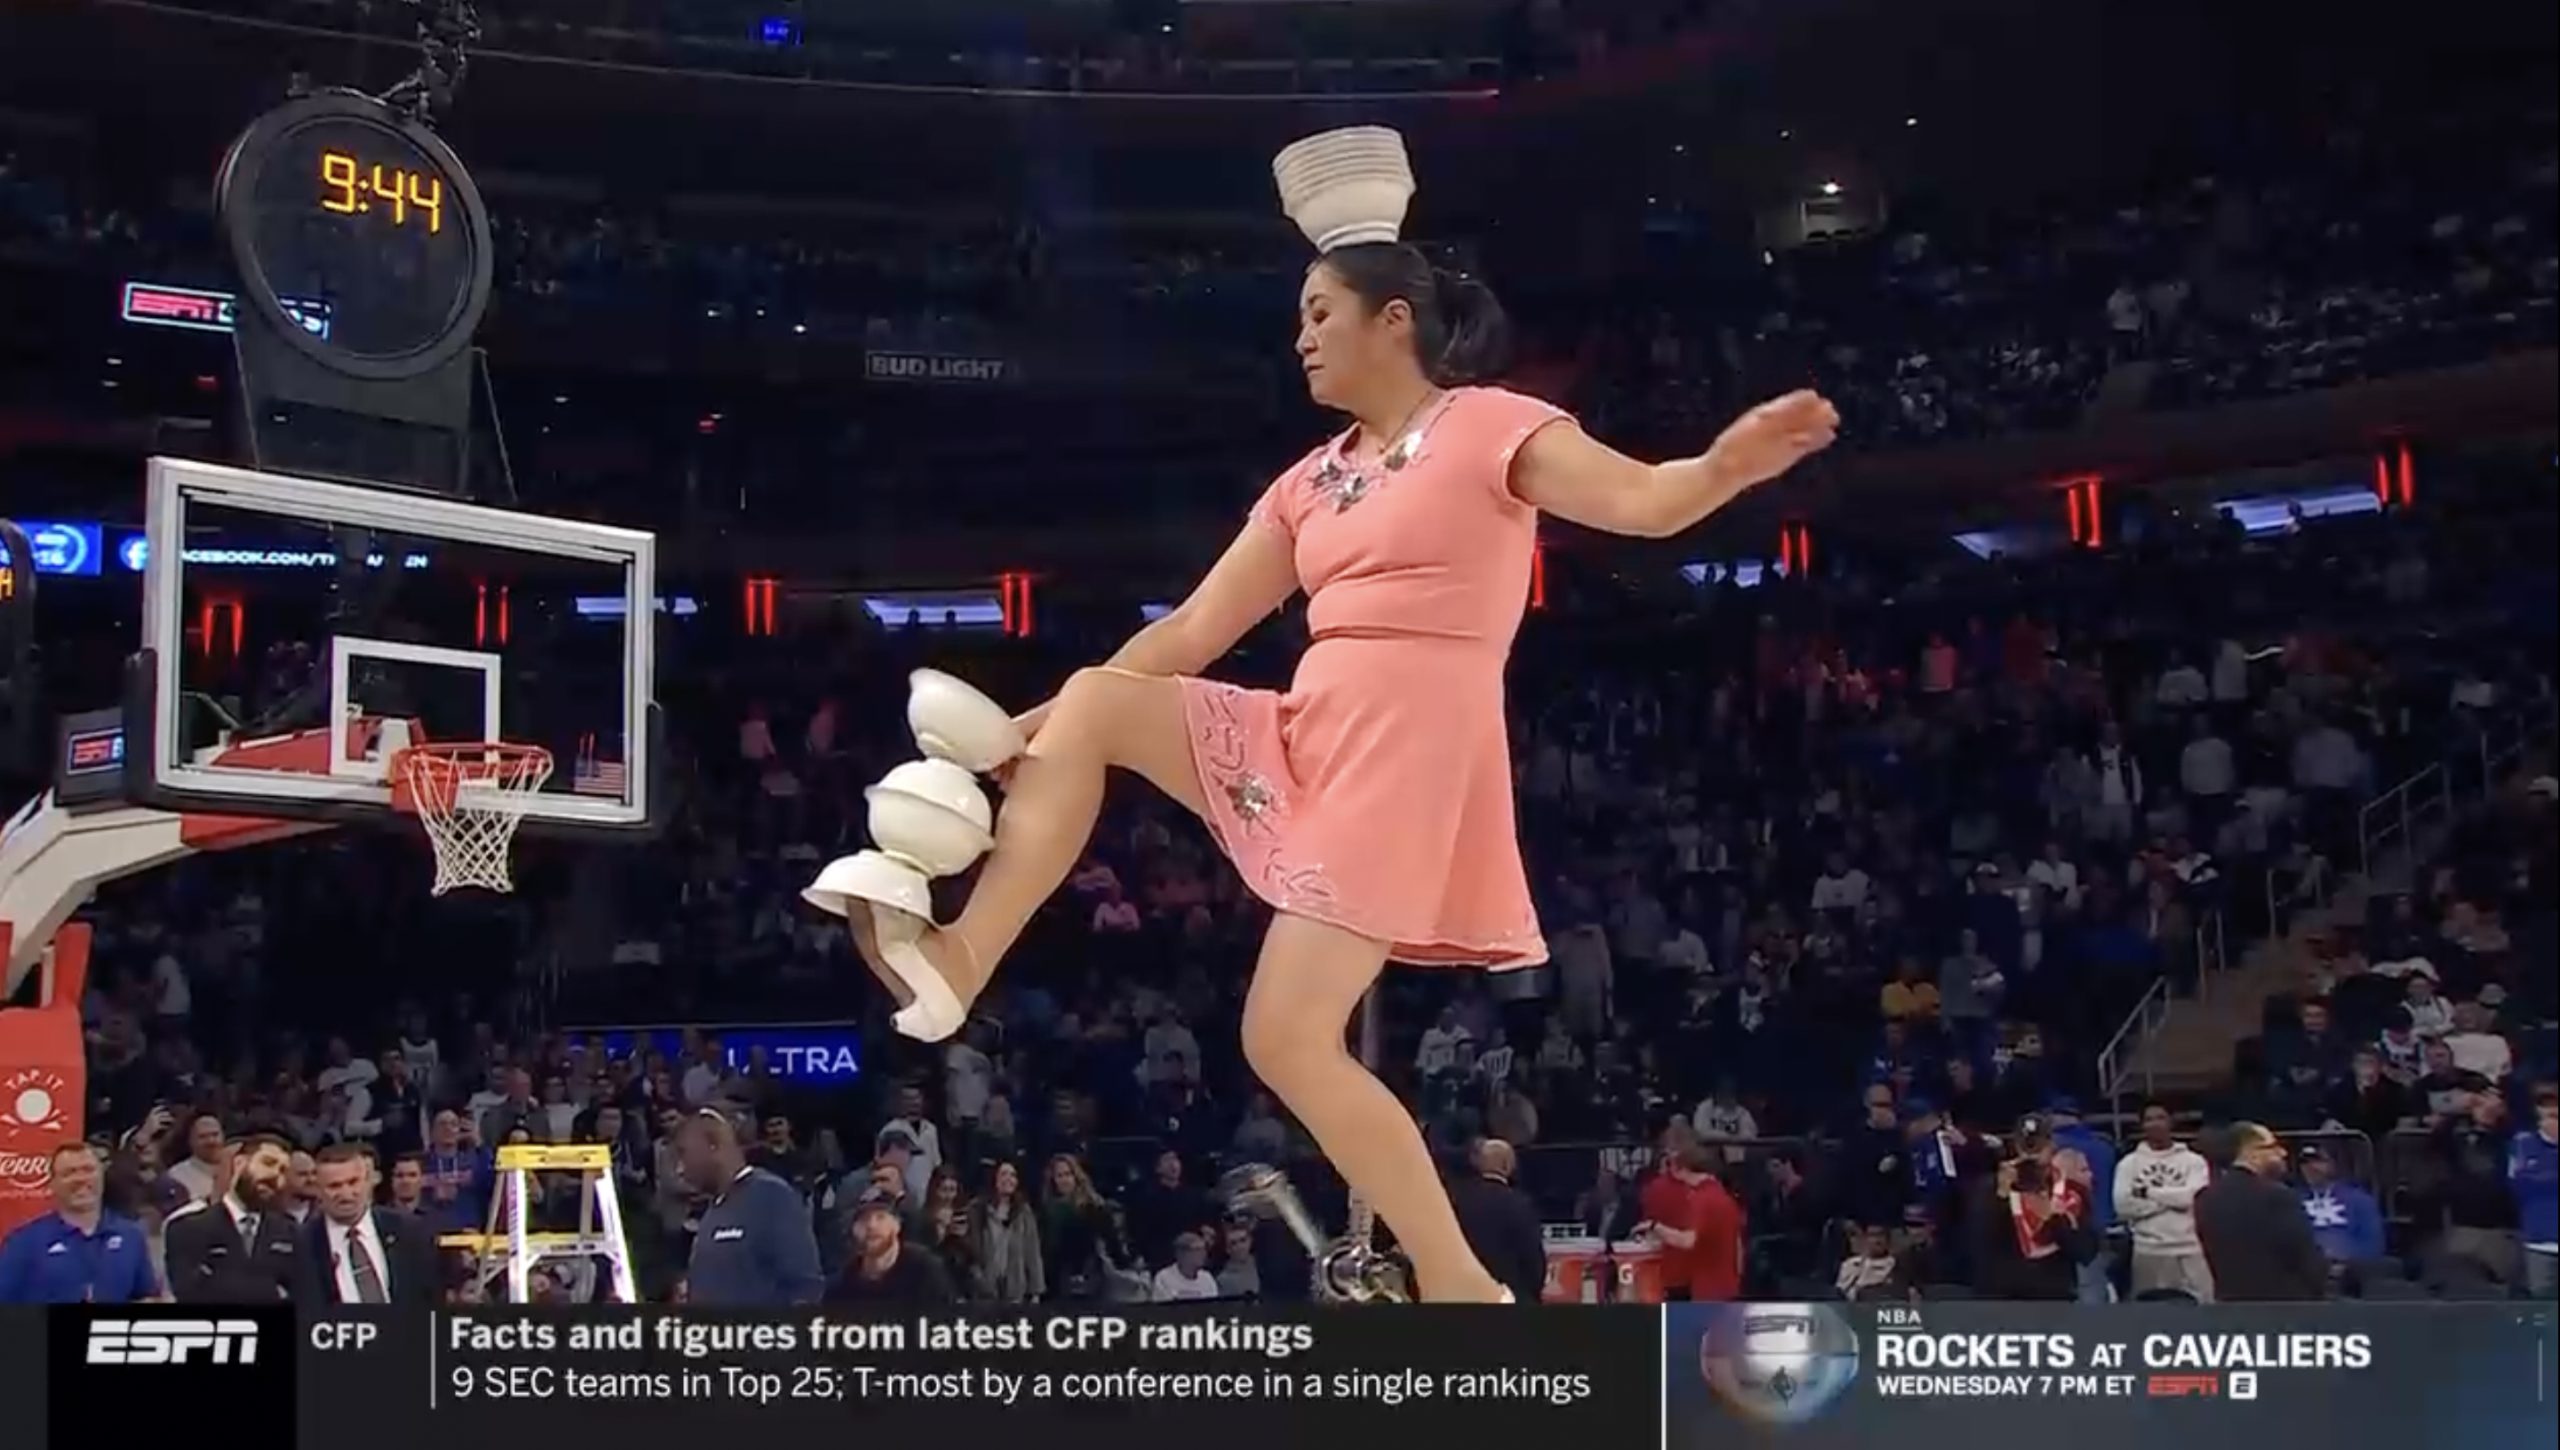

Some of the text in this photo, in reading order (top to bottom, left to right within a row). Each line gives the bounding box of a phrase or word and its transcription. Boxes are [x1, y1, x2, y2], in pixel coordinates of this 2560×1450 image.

[322, 153, 440, 232] 9:44
[872, 356, 1003, 379] BUD LIGHT
[5, 1069, 64, 1090] TAP IT
